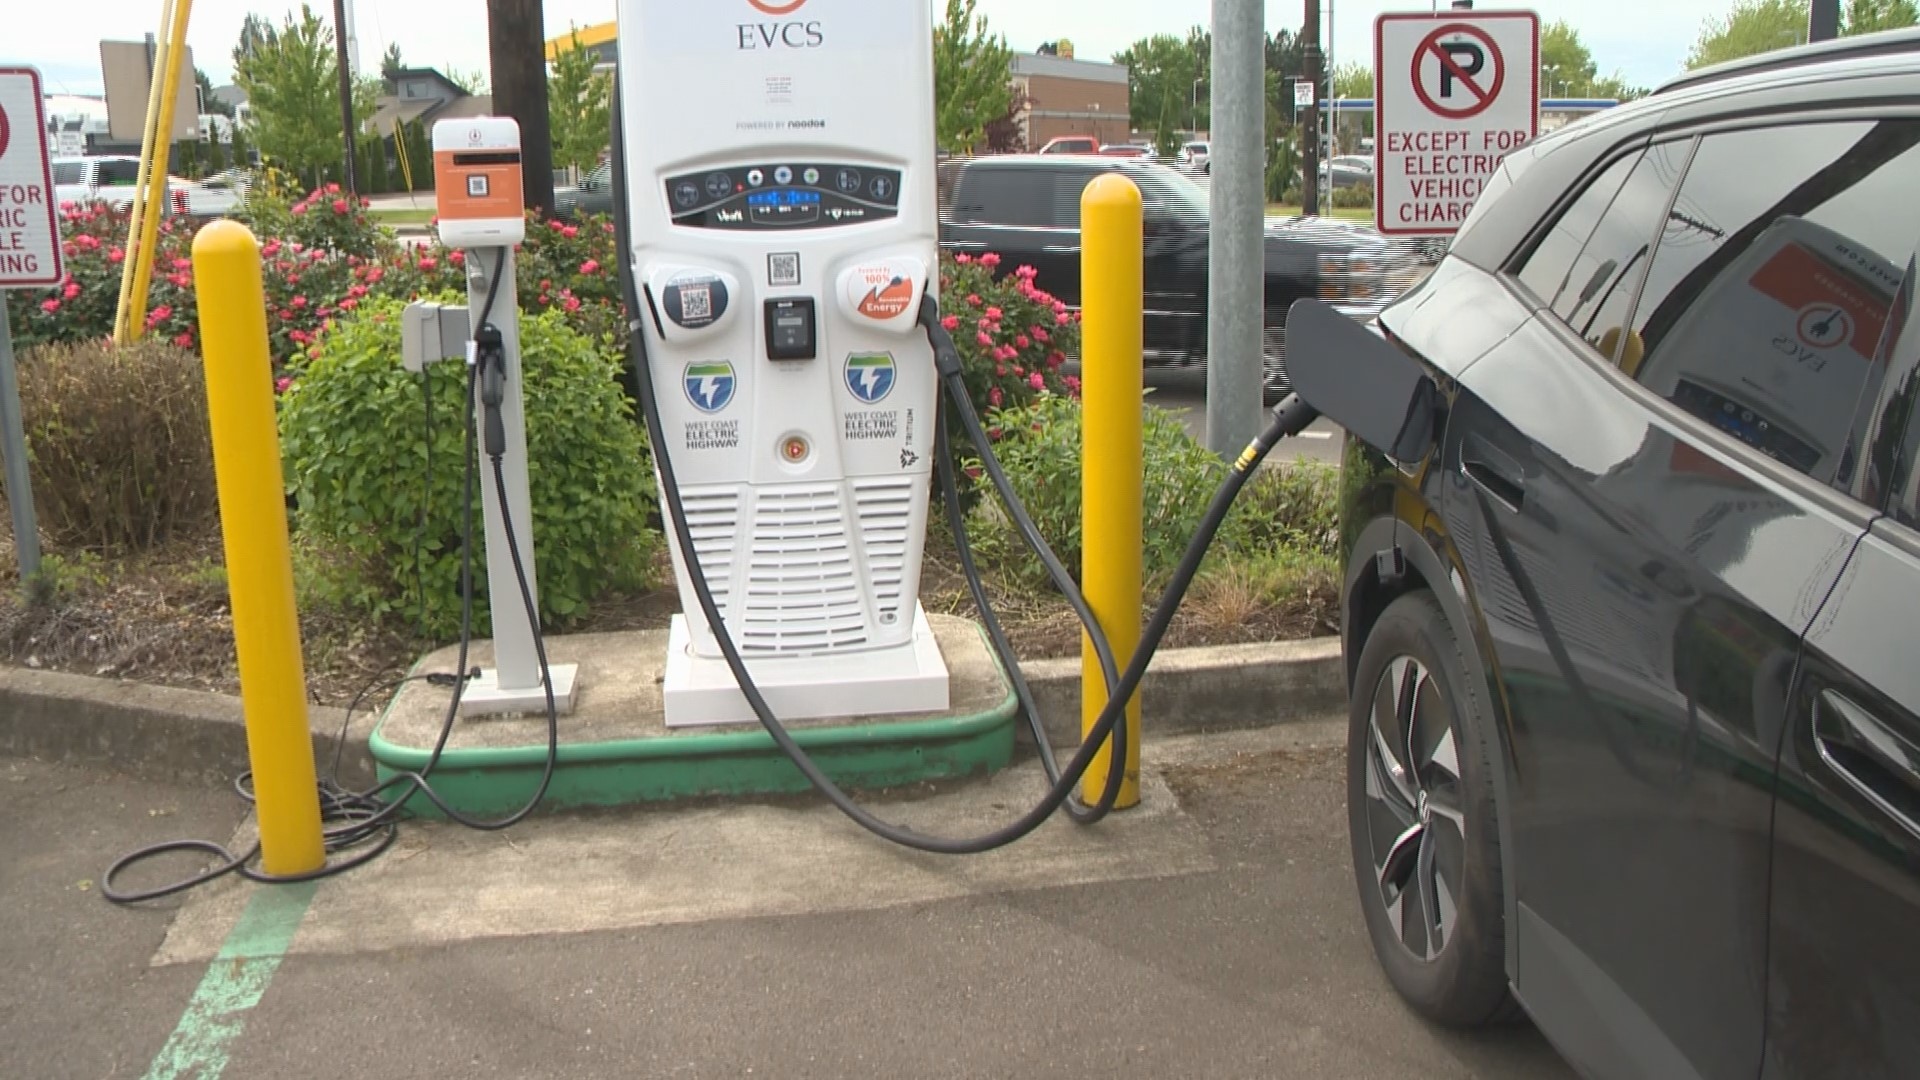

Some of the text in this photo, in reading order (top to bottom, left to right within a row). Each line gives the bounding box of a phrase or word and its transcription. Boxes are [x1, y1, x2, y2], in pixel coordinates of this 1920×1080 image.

[736, 20, 824, 50] EVCS
[1440, 42, 1484, 98] P
[736, 120, 774, 131] POWERED
[1387, 129, 1526, 152] EXCEPT FOR
[865, 273, 891, 285] 100%
[866, 302, 902, 314] Energy
[845, 410, 897, 421] WEST COAST
[685, 420, 738, 431] WEST COAST
[845, 420, 897, 430] ELECTRIC
[686, 430, 739, 440] ELECTRIC
[845, 430, 897, 440] HIGHWAY
[686, 440, 739, 450] HIGHWAY
